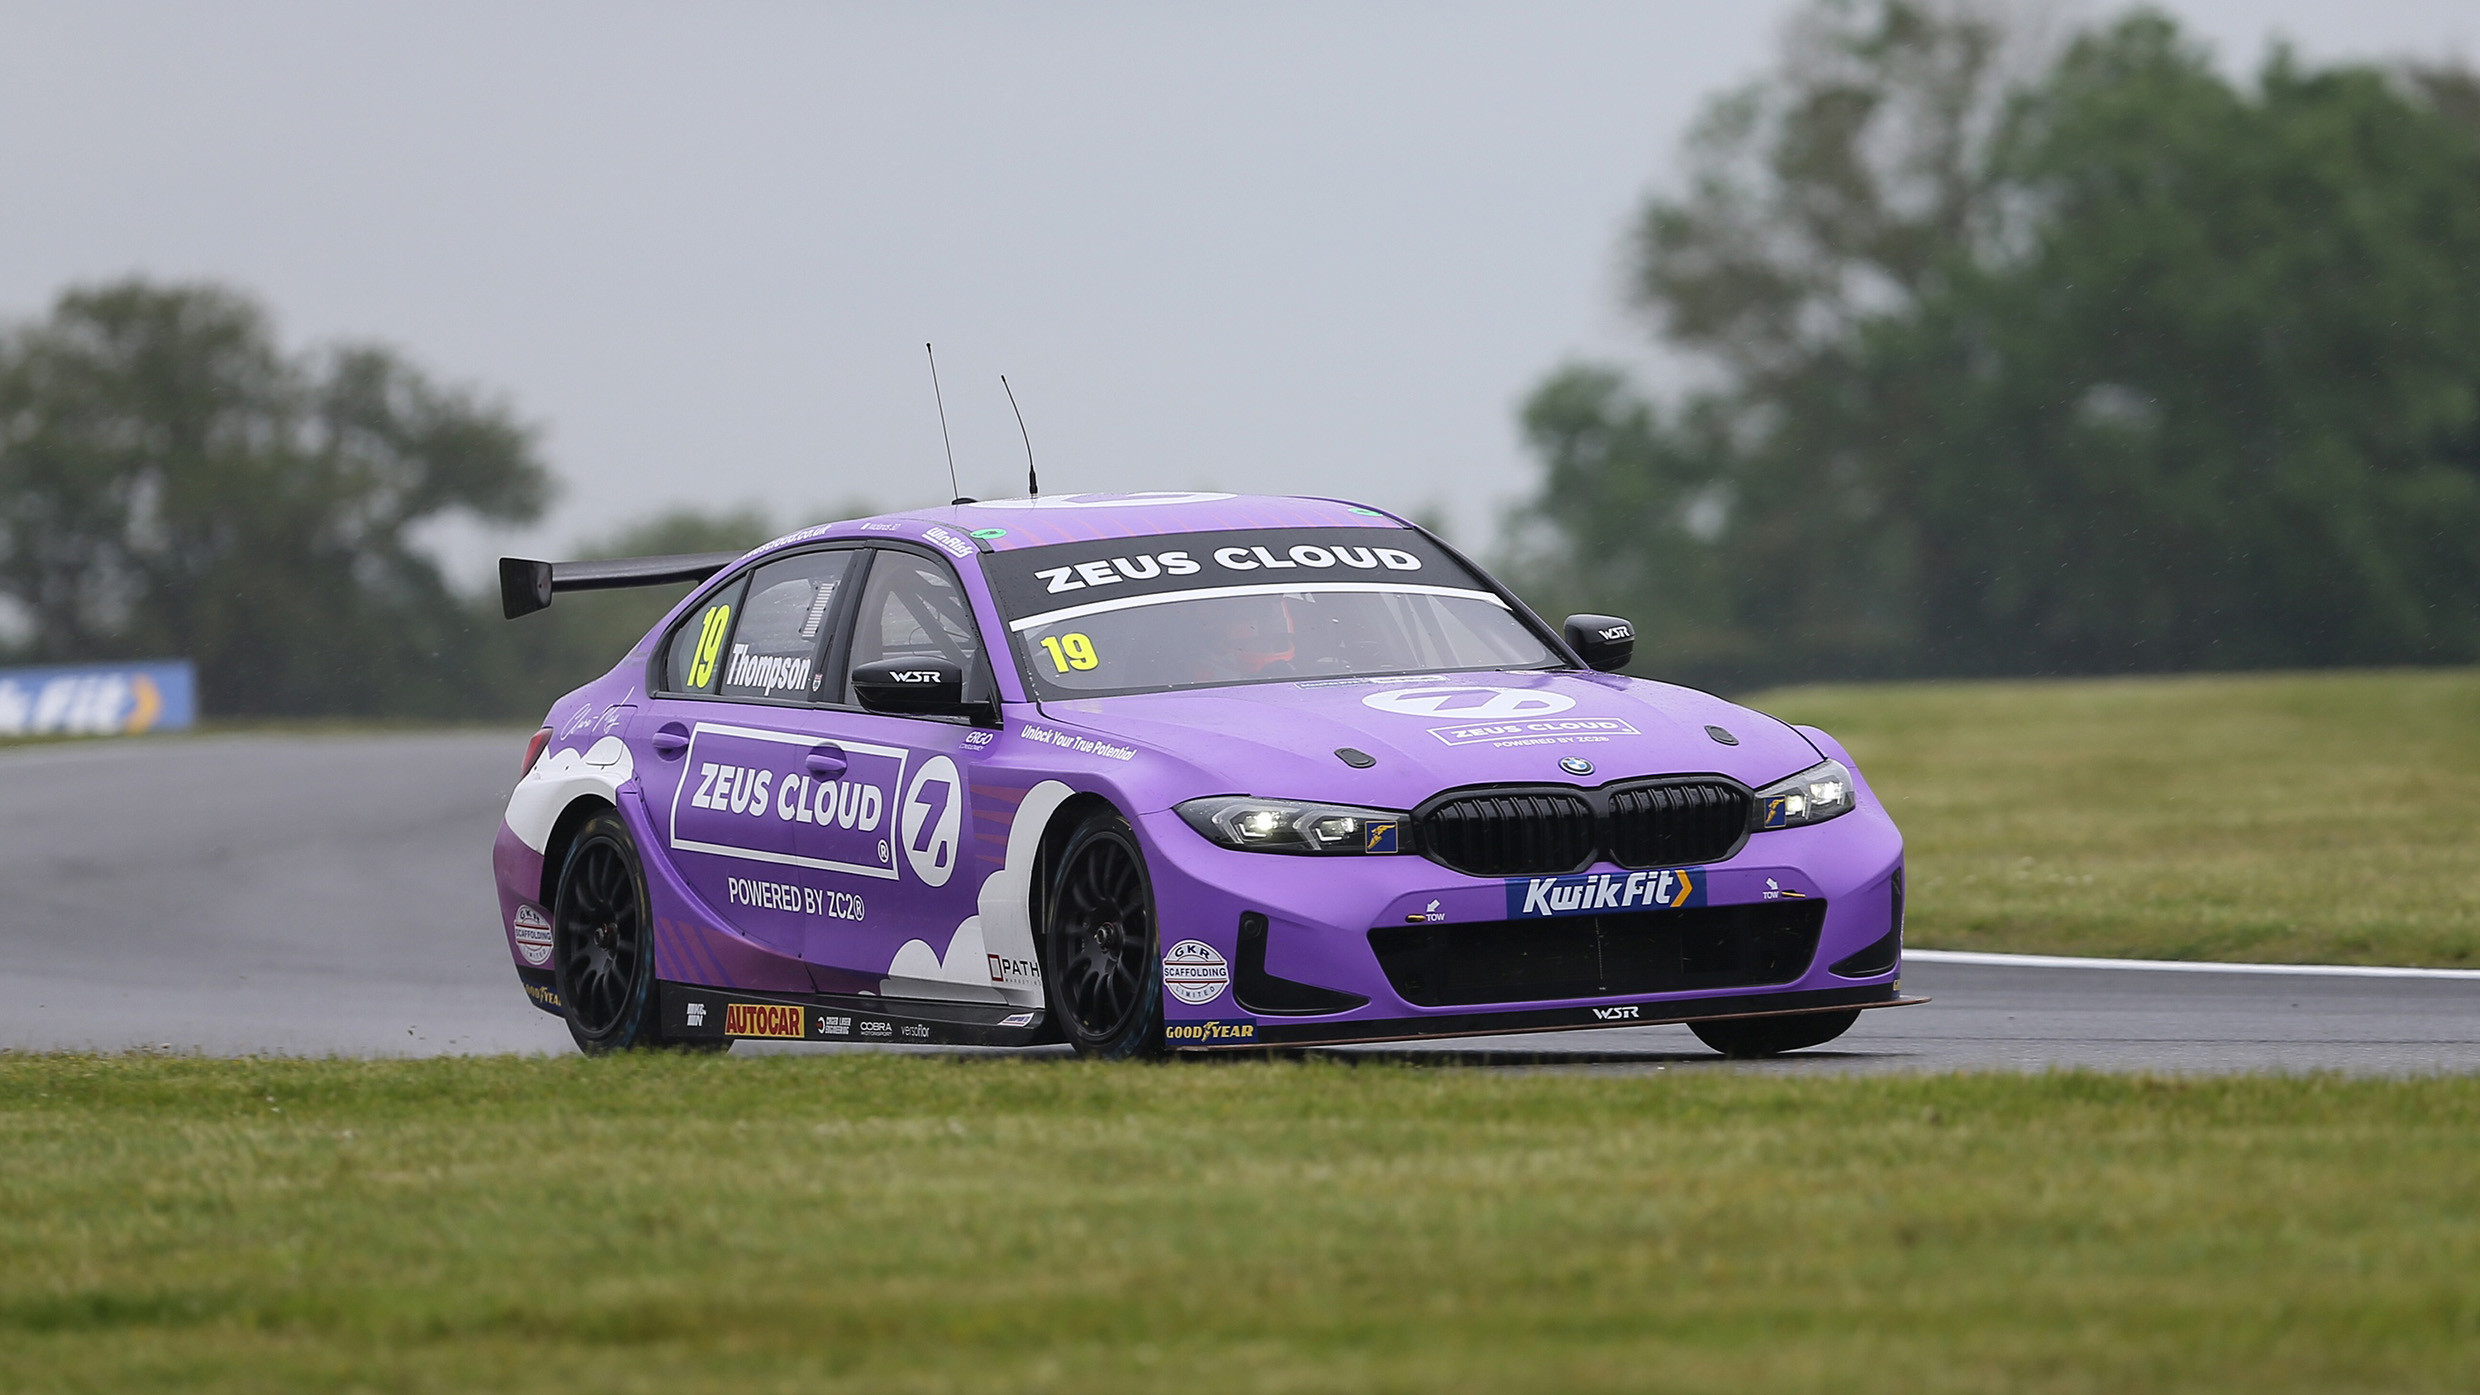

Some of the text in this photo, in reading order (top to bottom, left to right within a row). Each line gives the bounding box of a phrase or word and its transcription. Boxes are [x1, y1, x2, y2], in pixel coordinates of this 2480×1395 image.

[1034, 545, 1422, 594] ZEUS CLOUD
[1598, 626, 1630, 640] WSR
[686, 604, 730, 688] 19
[1040, 633, 1099, 673] 19
[726, 643, 811, 697] Thompson
[890, 671, 941, 683] WSR
[1450, 721, 1620, 739] ZEUS CLOUD
[965, 731, 994, 745] ERGO
[1020, 724, 1137, 761] Unlock Your True Potential
[1493, 737, 1555, 748] POWERED
[1558, 736, 1575, 744] BY
[691, 762, 883, 832] ZEUS CLOUD
[728, 877, 802, 912] POWERED
[804, 888, 823, 915] BY
[1762, 891, 1779, 900] TOW
[1425, 913, 1446, 922] TOW
[515, 929, 552, 941] SCAFFOLDING
[1174, 945, 1210, 959] GKR
[1002, 959, 1040, 977] PATH
[1164, 968, 1227, 977] SCAFFOLDING
[1175, 986, 1215, 998] LIMITED
[1592, 1006, 1640, 1019] WSR
[726, 1005, 801, 1037] AUTOCAR
